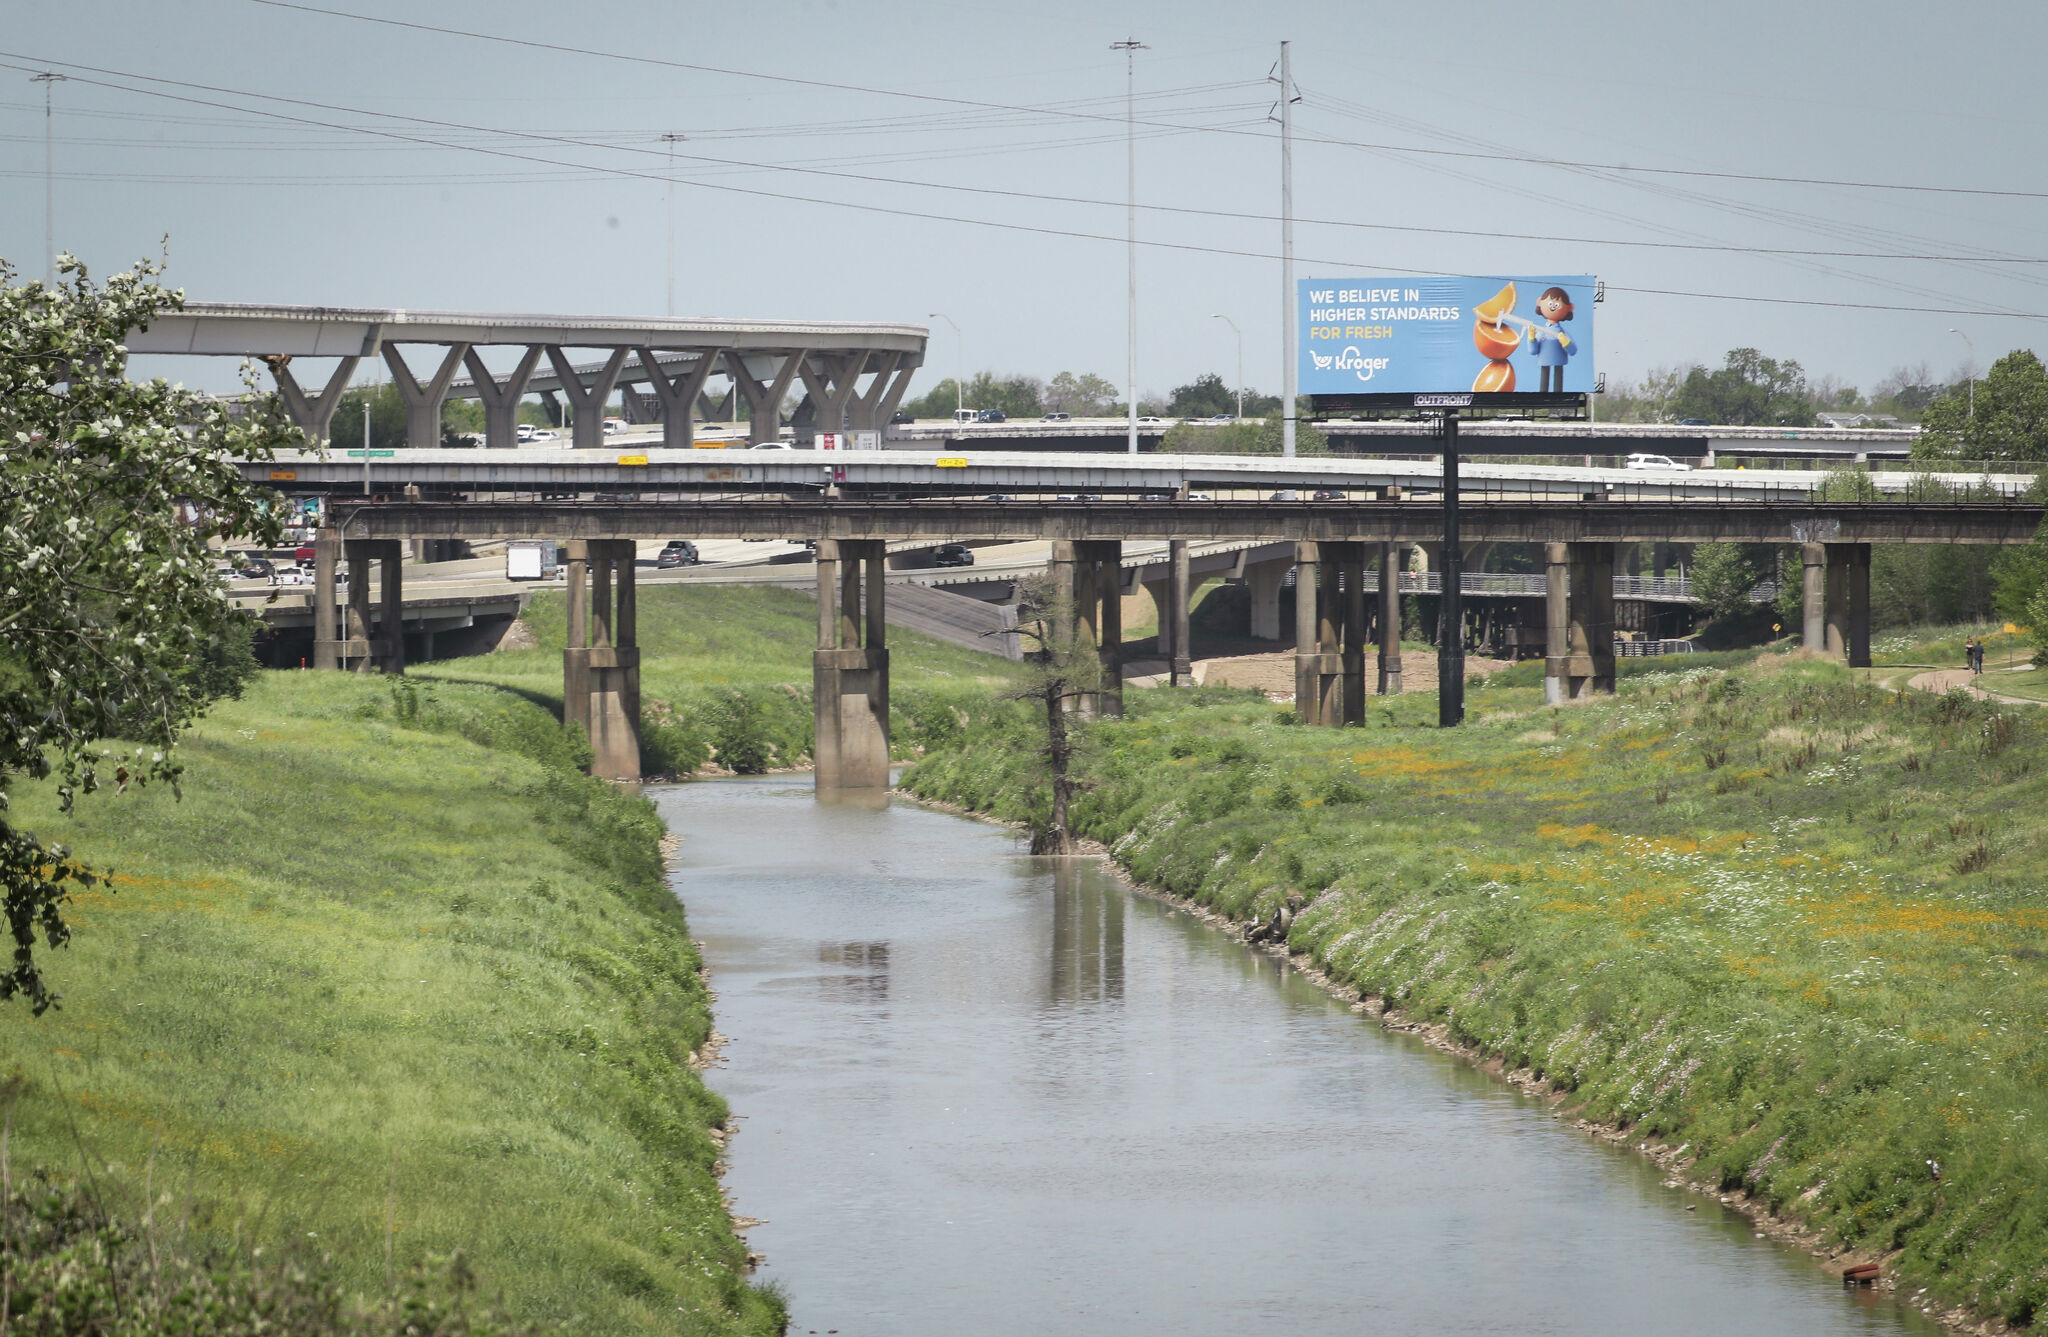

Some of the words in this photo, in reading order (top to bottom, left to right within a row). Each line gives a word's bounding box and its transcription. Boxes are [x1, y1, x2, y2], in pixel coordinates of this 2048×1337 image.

[1310, 290, 1334, 303] WE
[1339, 289, 1400, 302] BELIEVE
[1404, 289, 1419, 302] IN
[1310, 308, 1366, 322] HIGHER
[1370, 307, 1460, 320] STANDARDS
[1310, 326, 1341, 339] FOR
[1345, 326, 1393, 339] FRESH
[1335, 346, 1389, 381] Kroger
[1416, 395, 1471, 404] OUTFRONT
